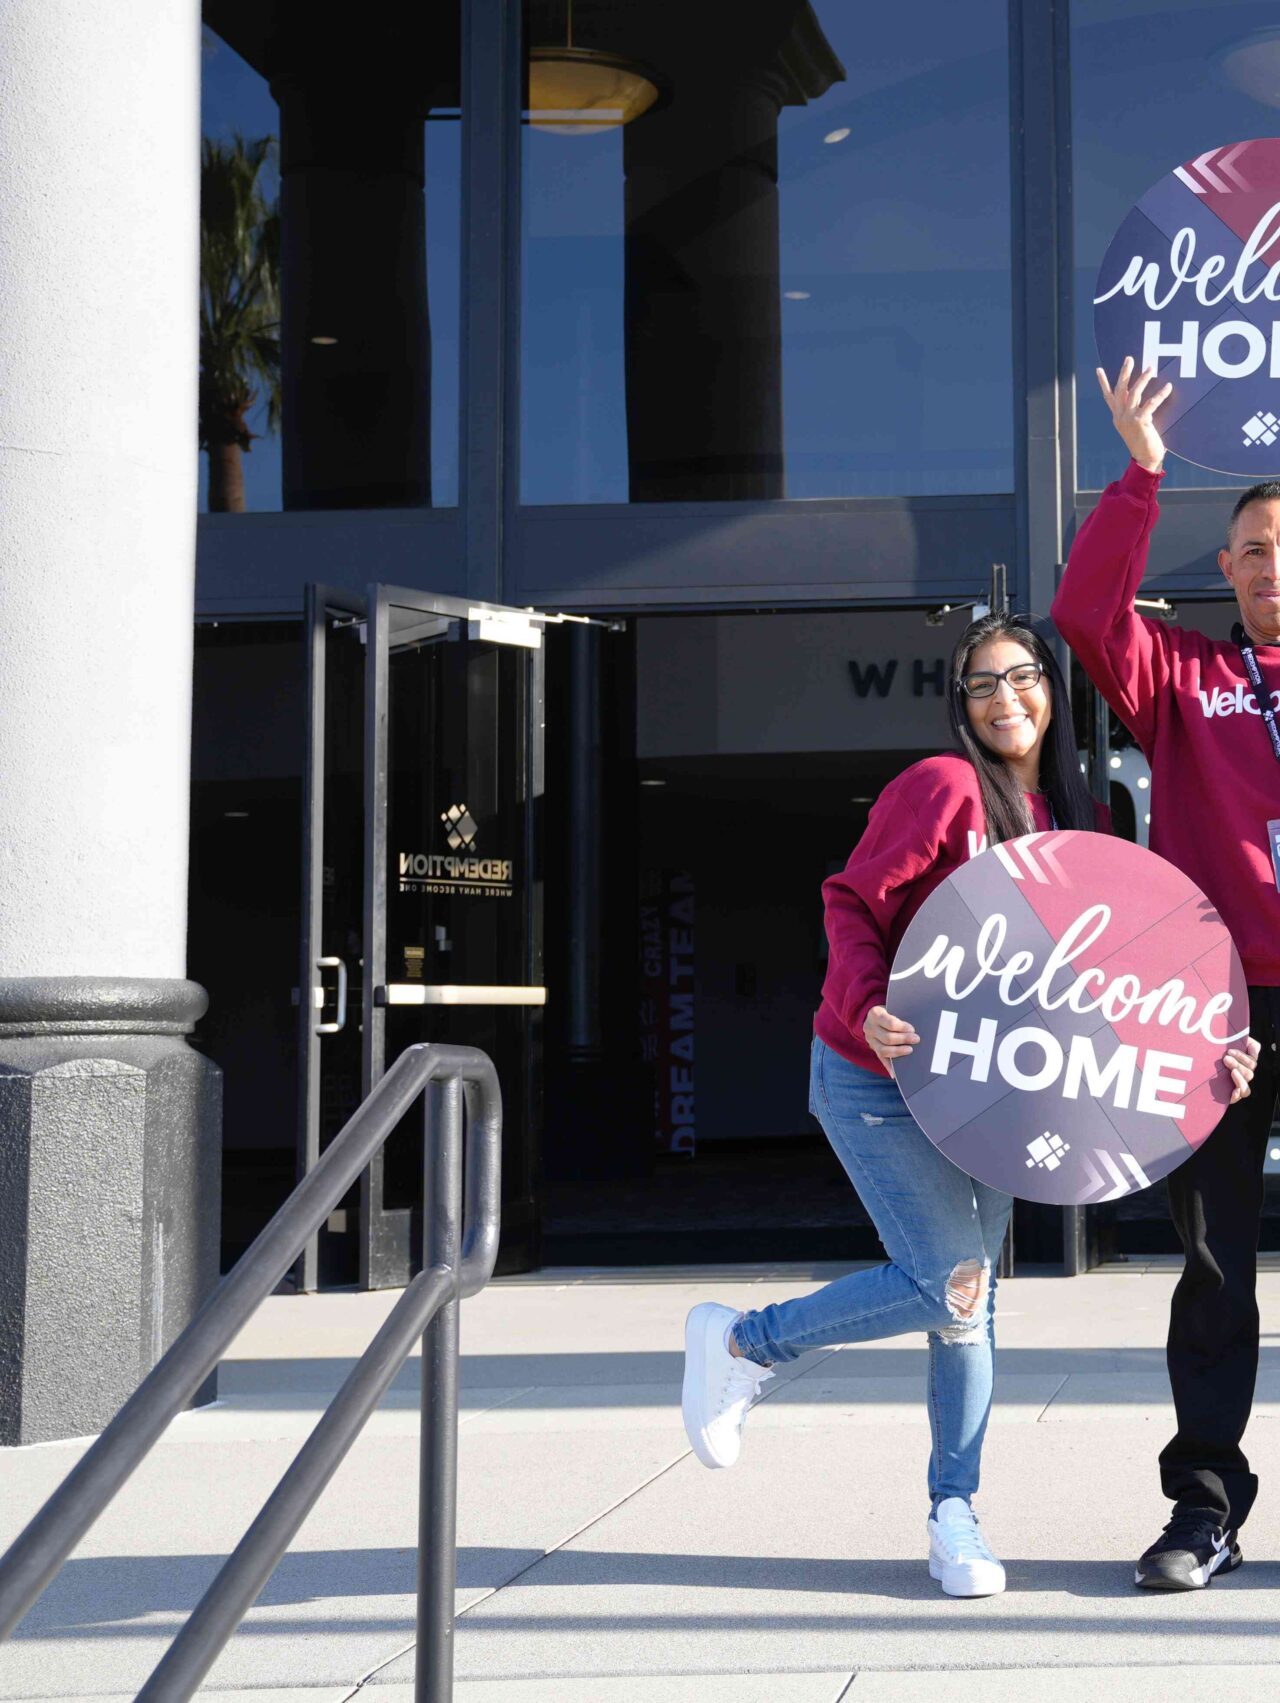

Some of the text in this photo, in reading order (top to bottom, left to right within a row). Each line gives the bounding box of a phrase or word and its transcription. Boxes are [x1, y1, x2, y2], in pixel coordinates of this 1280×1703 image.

[642, 904, 663, 977] CRAZY
[890, 904, 1250, 1044] welcome
[670, 993, 696, 1157] DREAM
[930, 1010, 1193, 1119] HOME
